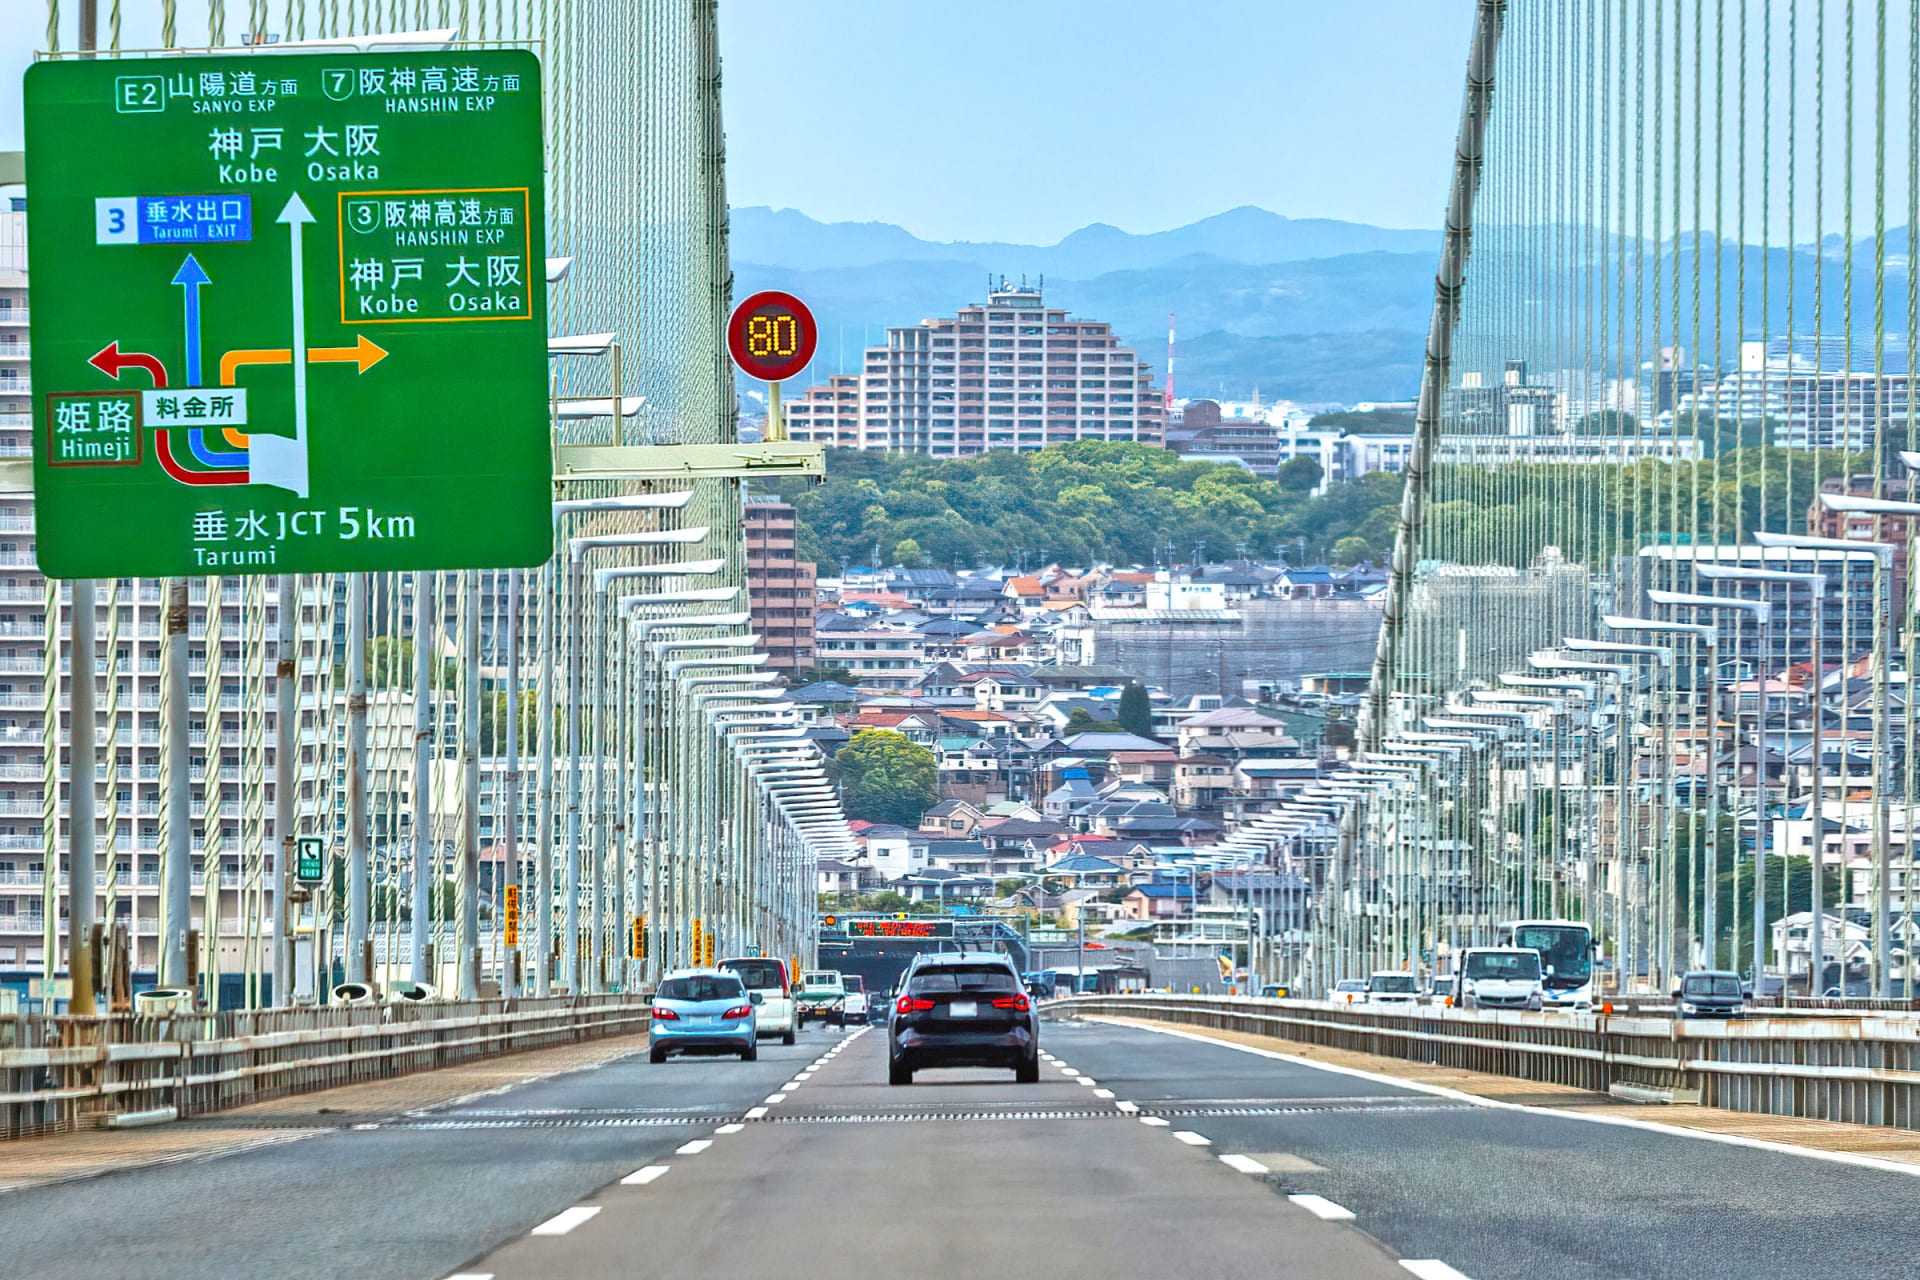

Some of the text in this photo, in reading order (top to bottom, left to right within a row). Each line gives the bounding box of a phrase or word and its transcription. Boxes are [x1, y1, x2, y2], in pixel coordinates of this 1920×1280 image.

[333, 74, 344, 91] 7
[126, 84, 155, 104] E2
[387, 97, 494, 111] HANSHIN EXP
[194, 100, 274, 112] SANYO EXP
[209, 126, 378, 160] 神戸 大阪
[220, 161, 377, 182] Kobe Osaka
[108, 201, 241, 235] 3 垂水出口
[359, 206, 371, 224] 3
[153, 224, 237, 238] Tarumi EXIT
[397, 230, 504, 245] HANSHIN EXP
[350, 256, 520, 290] 神戸 大阪
[361, 292, 519, 313] Kobe Osaka
[749, 316, 795, 355] 80
[57, 400, 131, 433] 姫路
[156, 396, 234, 419] 料金所
[62, 437, 130, 462] Himeji
[340, 508, 414, 539] 5km
[194, 546, 274, 565] Tarumi
